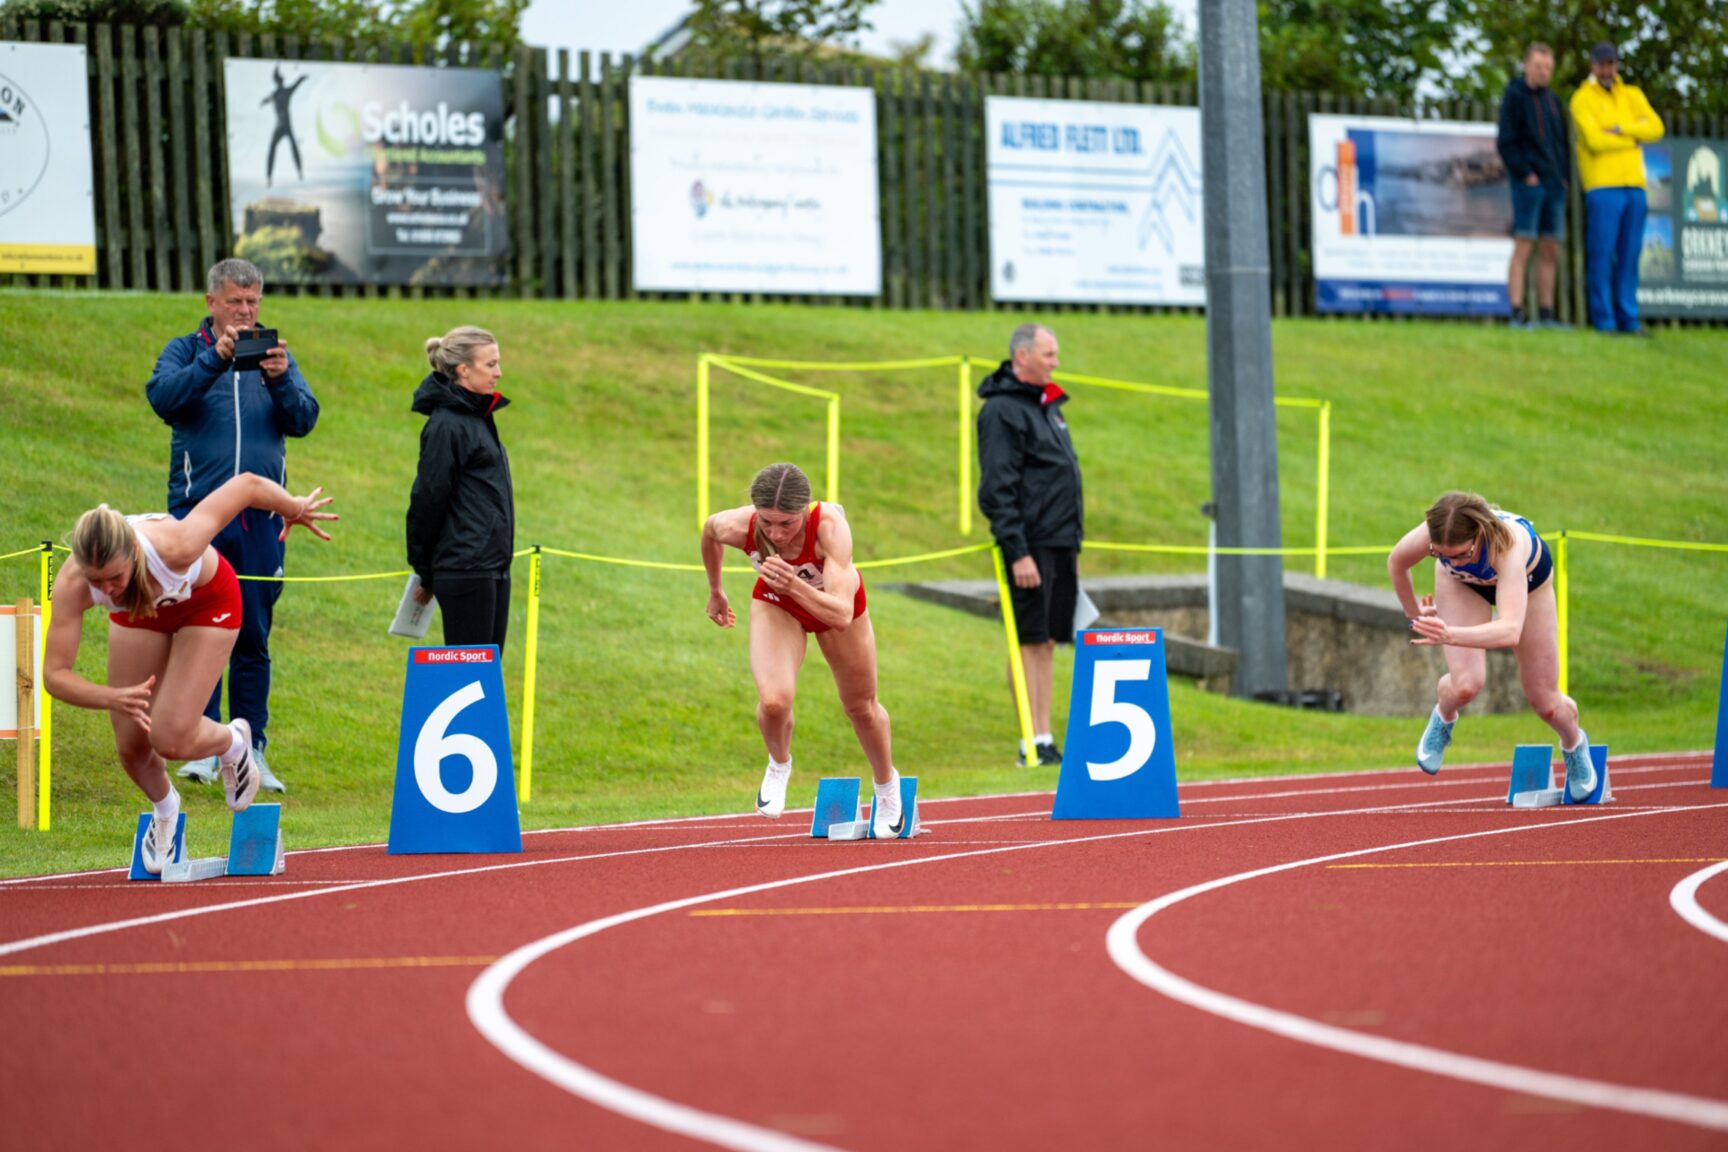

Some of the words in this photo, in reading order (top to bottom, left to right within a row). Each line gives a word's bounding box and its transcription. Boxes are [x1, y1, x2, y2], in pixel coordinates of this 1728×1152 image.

[362, 100, 486, 146] Scholes
[1001, 122, 1059, 149] ALFRED
[1065, 124, 1108, 153] FLETT
[1681, 226, 1728, 258] ORKNE
[1125, 633, 1150, 644] Sport
[460, 651, 486, 663] Sport
[1086, 659, 1156, 781] 5
[413, 680, 498, 814] 6
